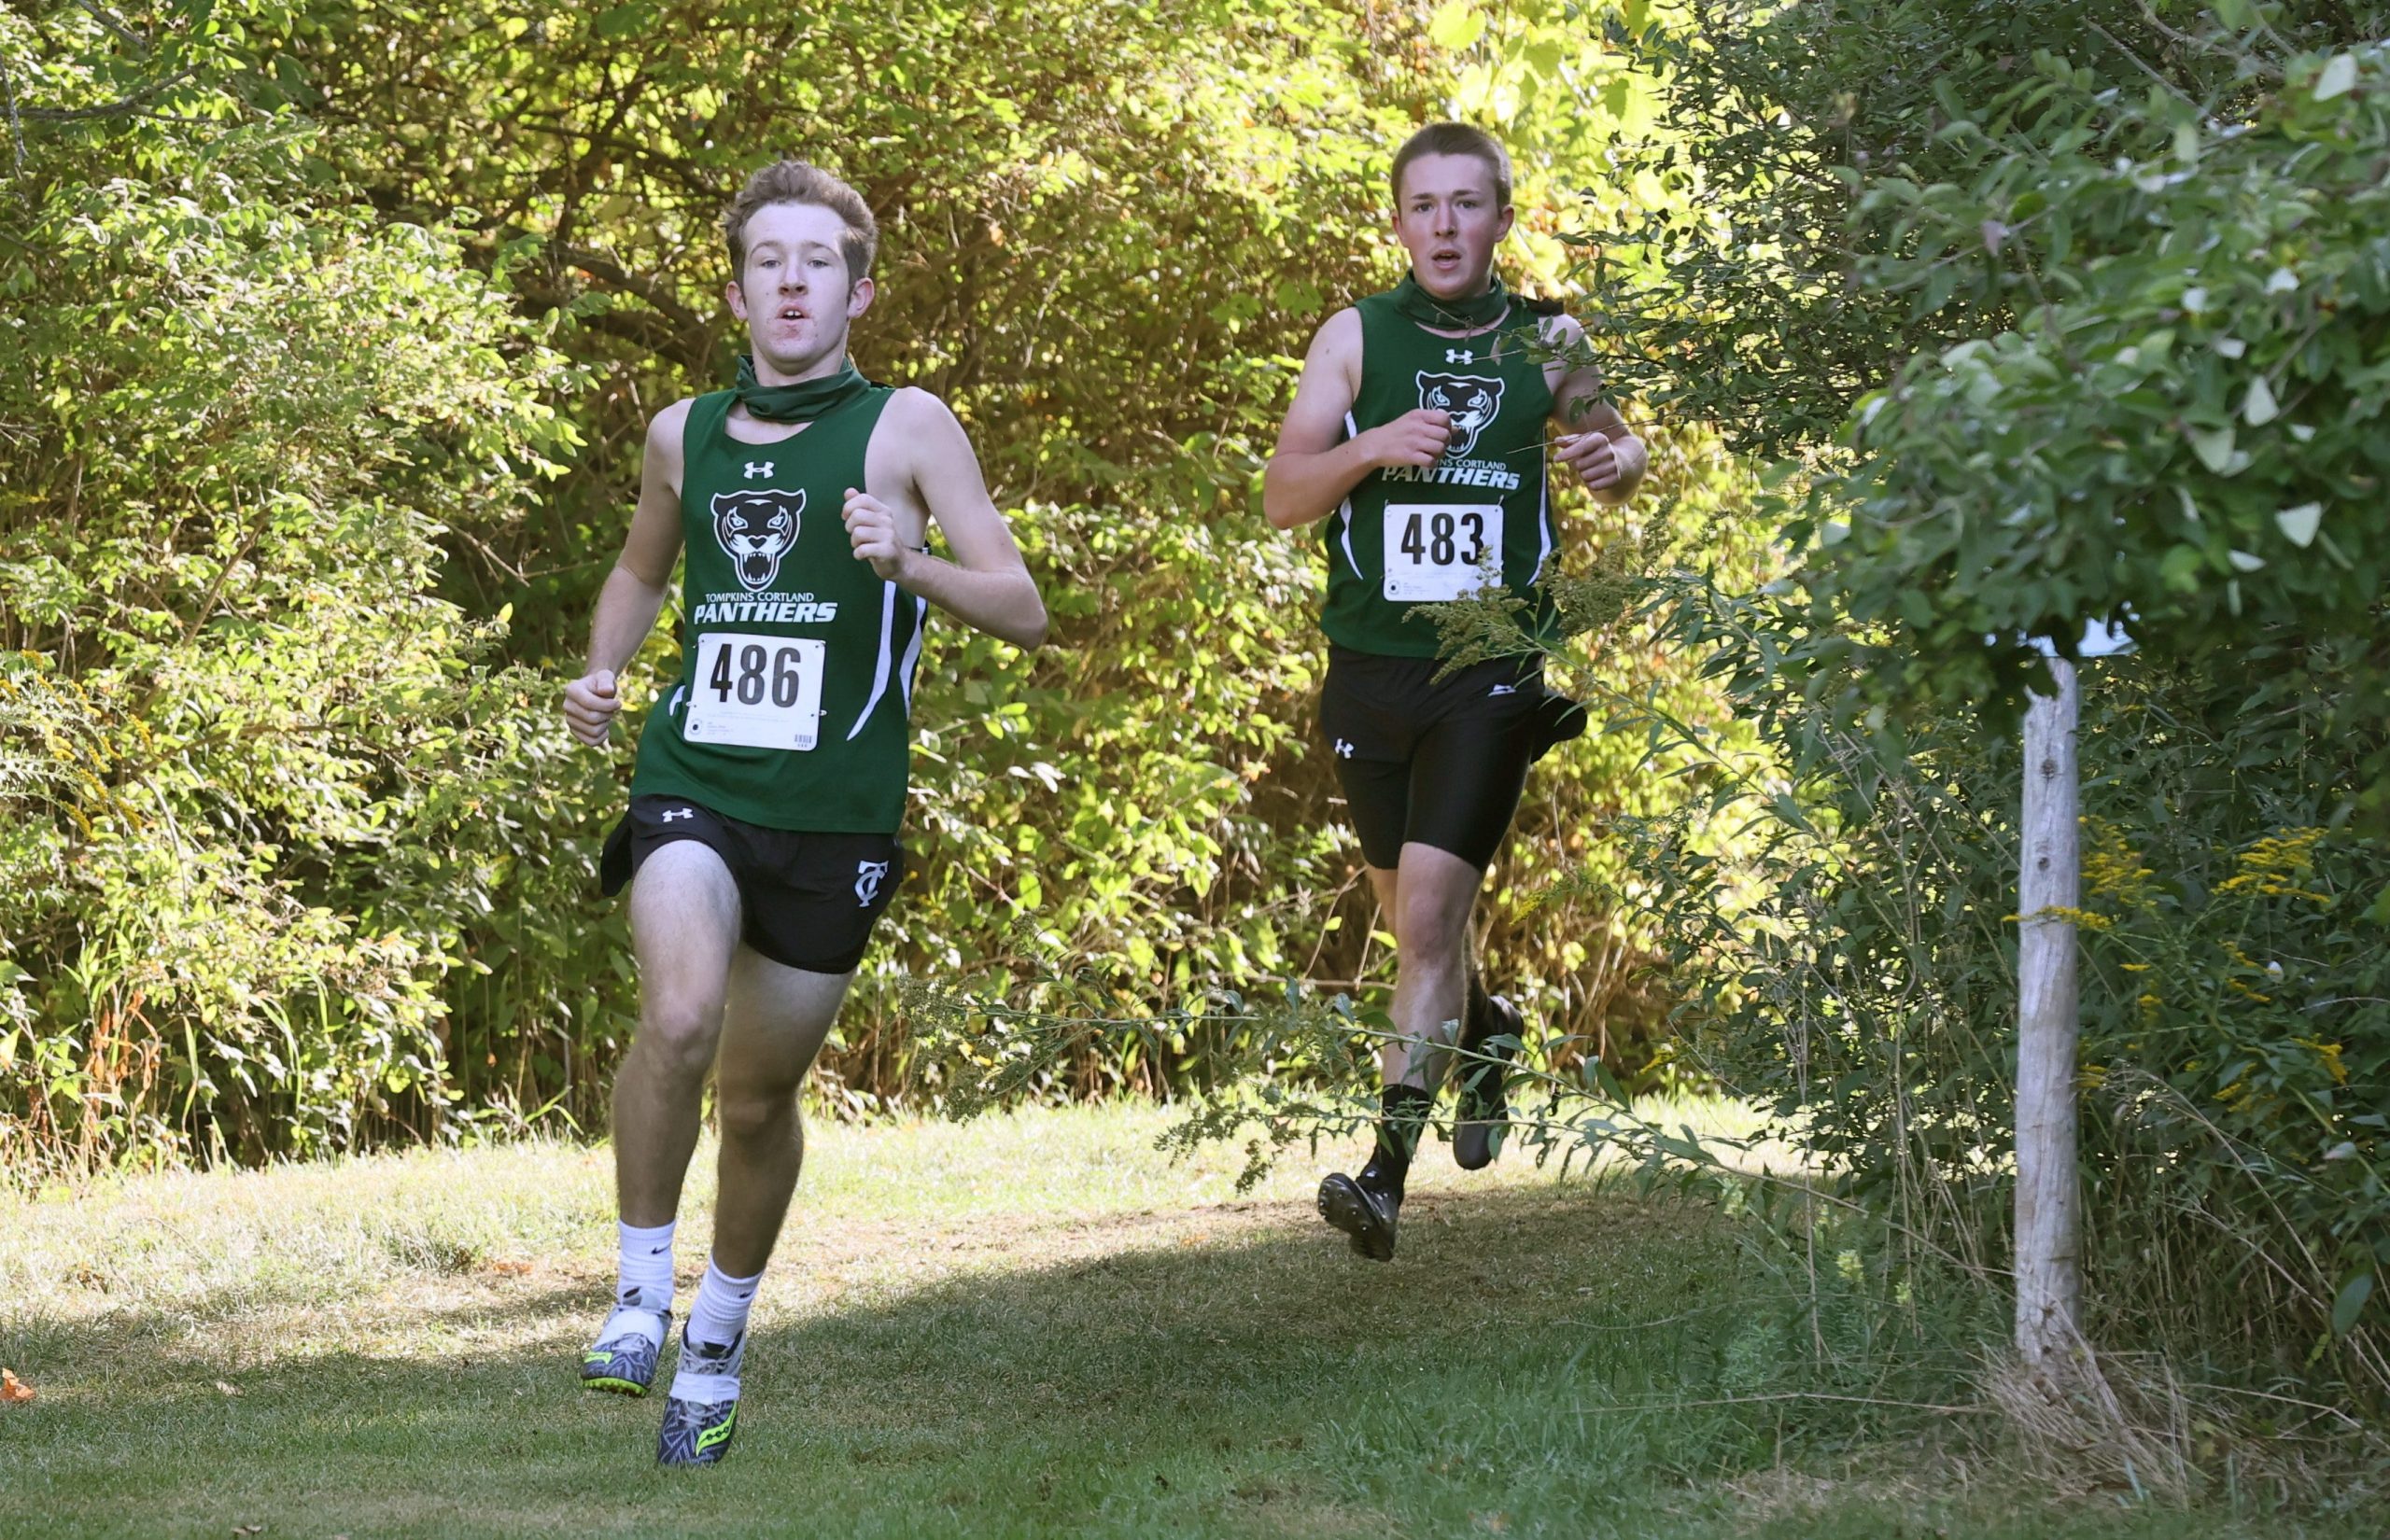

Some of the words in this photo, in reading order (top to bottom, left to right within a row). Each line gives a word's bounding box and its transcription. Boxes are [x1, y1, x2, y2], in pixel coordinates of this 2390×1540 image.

[1455, 459, 1506, 471] CORTLAND
[1382, 466, 1521, 490] PANTHERS
[1401, 512, 1484, 566] 483
[706, 592, 754, 603] TOMPKINS
[757, 592, 814, 602] CORTLAND
[694, 602, 838, 625] PANTHERS
[710, 642, 801, 708] 486
